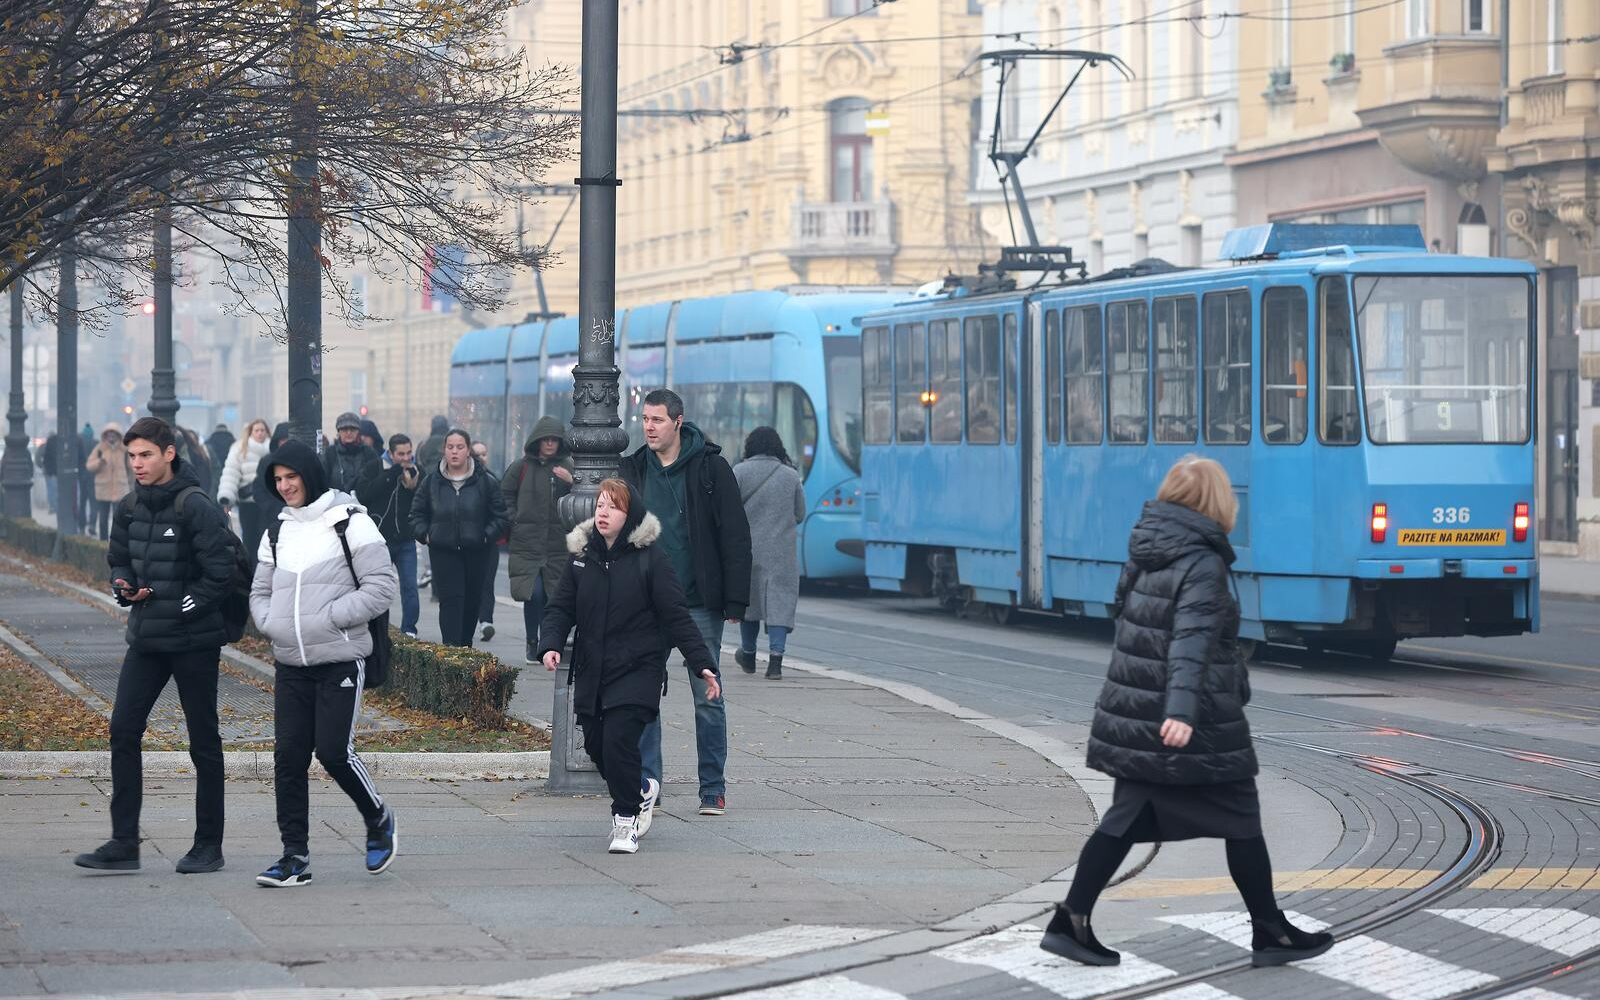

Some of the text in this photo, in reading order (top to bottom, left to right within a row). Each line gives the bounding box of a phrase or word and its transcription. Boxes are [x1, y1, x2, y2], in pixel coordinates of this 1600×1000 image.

[1437, 401, 1451, 431] 9
[1432, 507, 1470, 523] 336
[1402, 532, 1500, 543] PAZITE NA RAZMAK!
